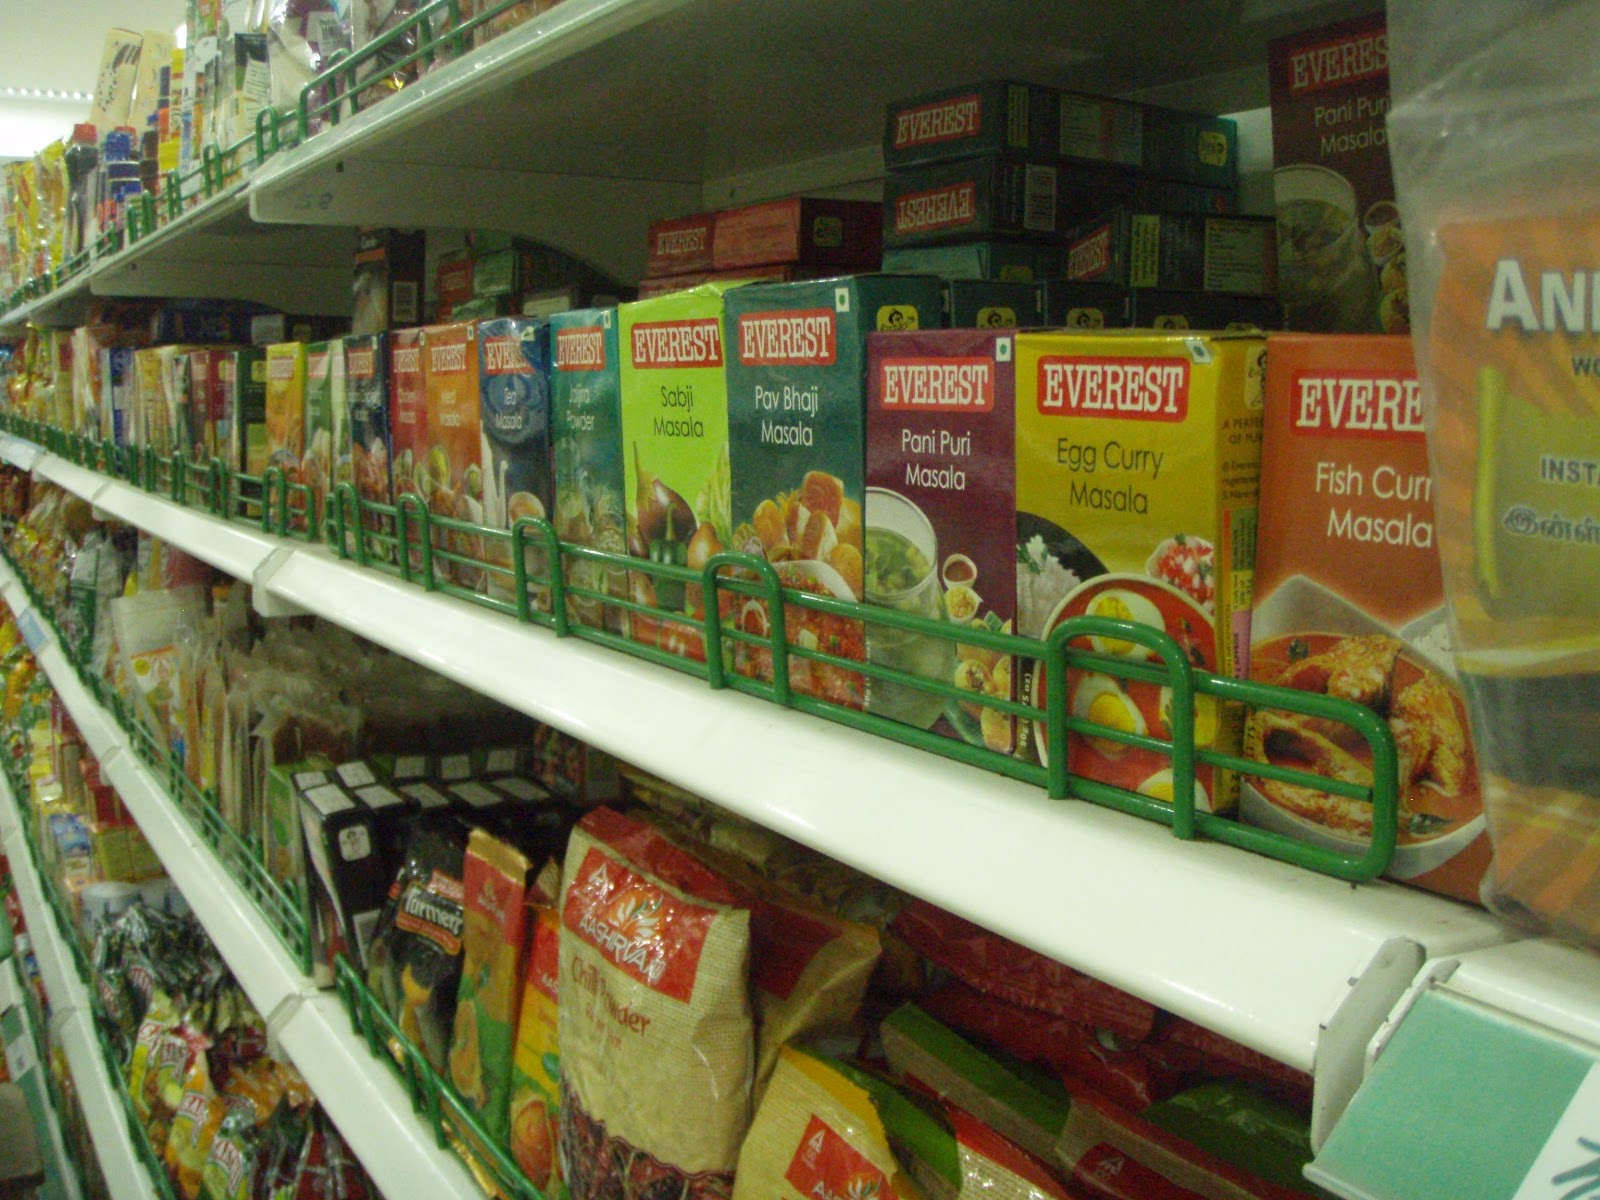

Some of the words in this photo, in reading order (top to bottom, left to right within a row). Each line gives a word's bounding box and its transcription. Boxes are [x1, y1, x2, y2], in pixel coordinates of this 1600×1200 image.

[1291, 36, 1388, 90] EVERES
[896, 101, 978, 144] EVEREST
[1315, 100, 1352, 127] Pani
[1321, 126, 1386, 153] Masala
[898, 188, 971, 229] EVEREST
[656, 227, 706, 255] EVEREST
[558, 332, 602, 365] EVEREST
[634, 325, 719, 363] EVEREST
[742, 316, 831, 358] EVEREST
[431, 343, 466, 372] EVEREST
[504, 388, 516, 405] Tea
[661, 386, 693, 412] Sabji
[755, 385, 779, 410] Pav
[784, 385, 818, 418] Bhaji
[884, 365, 989, 405] EVEREST
[1043, 363, 1184, 414] EVEREST
[496, 413, 522, 429] Masala
[567, 410, 595, 431] Powder
[1296, 378, 1425, 432] EVERE
[654, 417, 703, 437] Masala
[761, 419, 813, 447] Masala
[902, 429, 936, 454] Pani
[940, 431, 971, 456] Puri
[1057, 438, 1097, 473] Egg
[1103, 441, 1164, 480] Curry
[905, 463, 966, 491] Masala
[1316, 462, 1362, 496] Fish
[1372, 466, 1432, 502] Curr
[1070, 480, 1148, 515] Masala
[1327, 507, 1432, 548] Masala
